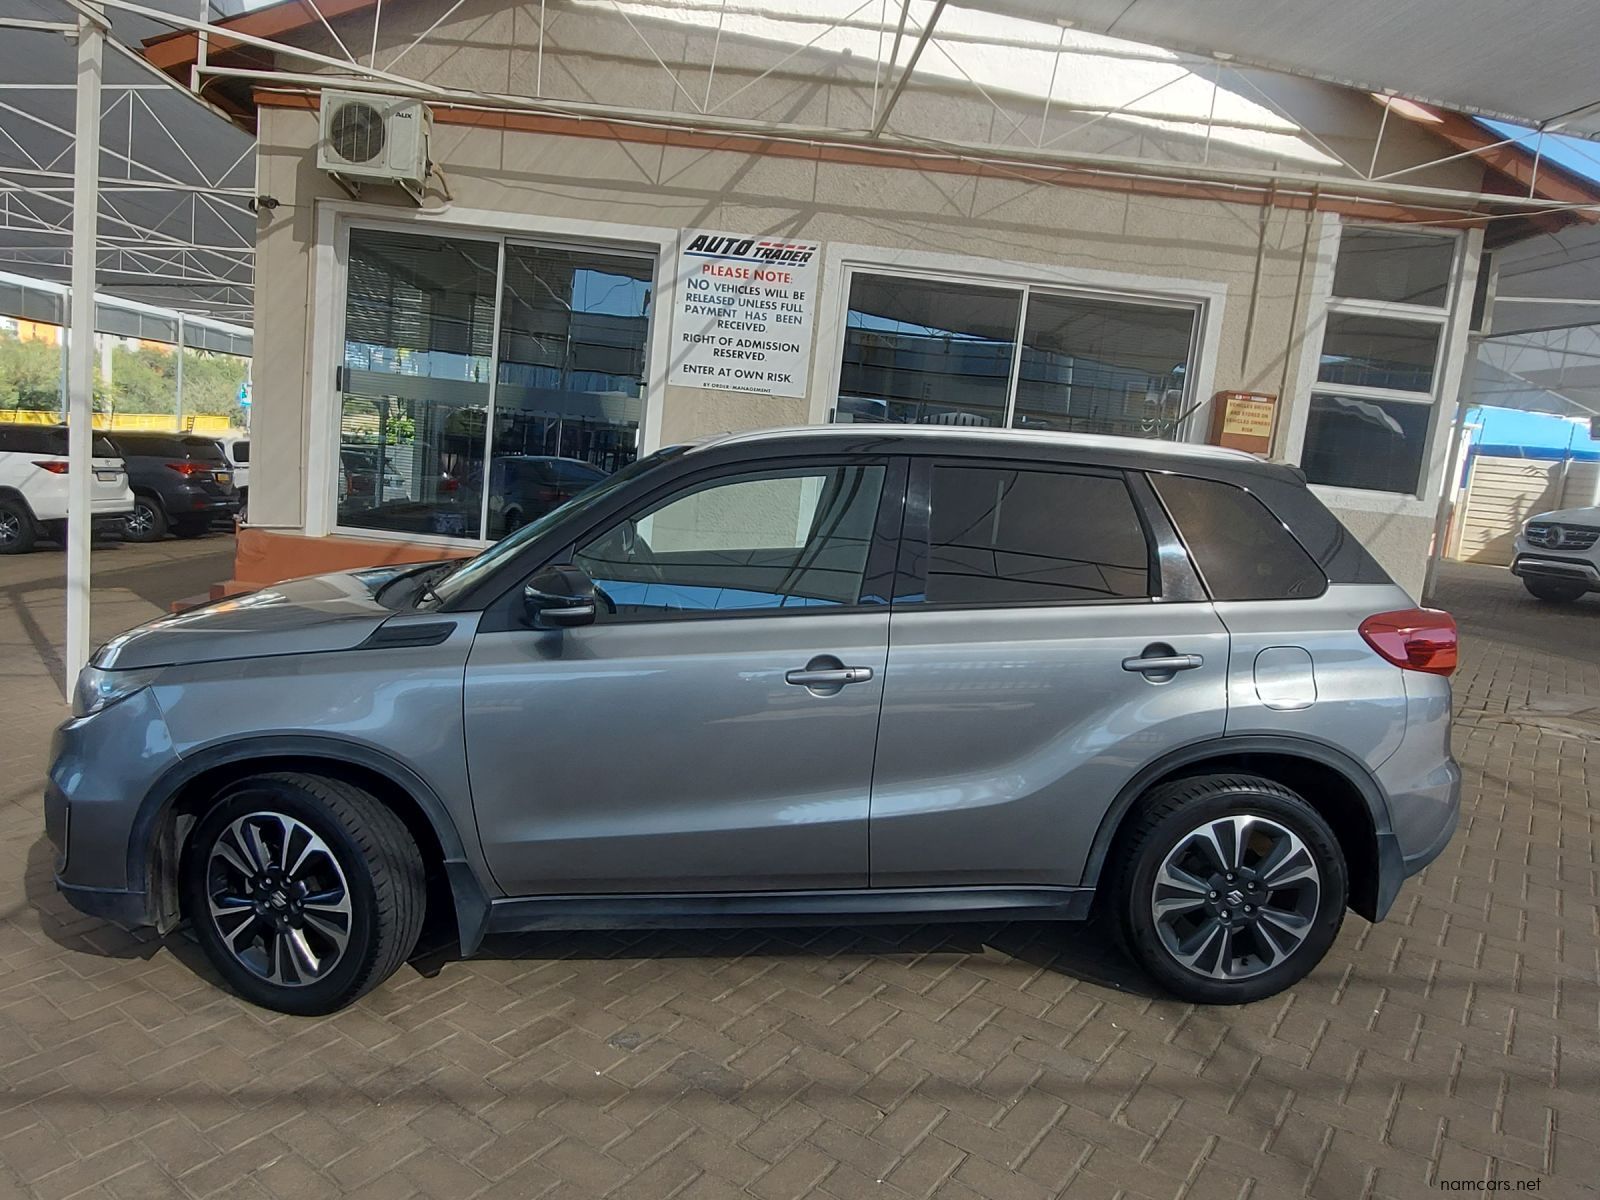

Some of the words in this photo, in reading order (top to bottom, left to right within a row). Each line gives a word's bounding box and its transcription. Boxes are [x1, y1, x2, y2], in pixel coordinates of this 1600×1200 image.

[395, 111, 412, 119] AUX
[686, 235, 755, 256] AUTO
[752, 247, 813, 263] TRADER
[702, 264, 749, 279] PLEASE
[753, 269, 793, 284] NOTE:
[687, 278, 709, 290] NO
[714, 283, 761, 296] VEHICLES
[764, 288, 789, 299] WILL
[793, 291, 805, 300] BE
[686, 293, 735, 306] RELEASED
[738, 299, 777, 310] UNLESS
[781, 302, 803, 313] FULL
[685, 304, 737, 318] PAYMENT
[745, 311, 768, 321] HAS
[775, 314, 802, 324] BEEN
[718, 320, 768, 333] RECEIVED.
[682, 333, 715, 345] RIGHT
[718, 336, 734, 346] OF
[736, 339, 800, 353] ADMISSION
[713, 348, 767, 362] RESERVED.
[683, 364, 715, 375] ENTER
[718, 368, 732, 377] AT
[734, 369, 764, 380] OWN
[767, 372, 794, 383] RISK.
[732, 385, 771, 393] MANAGEMENT
